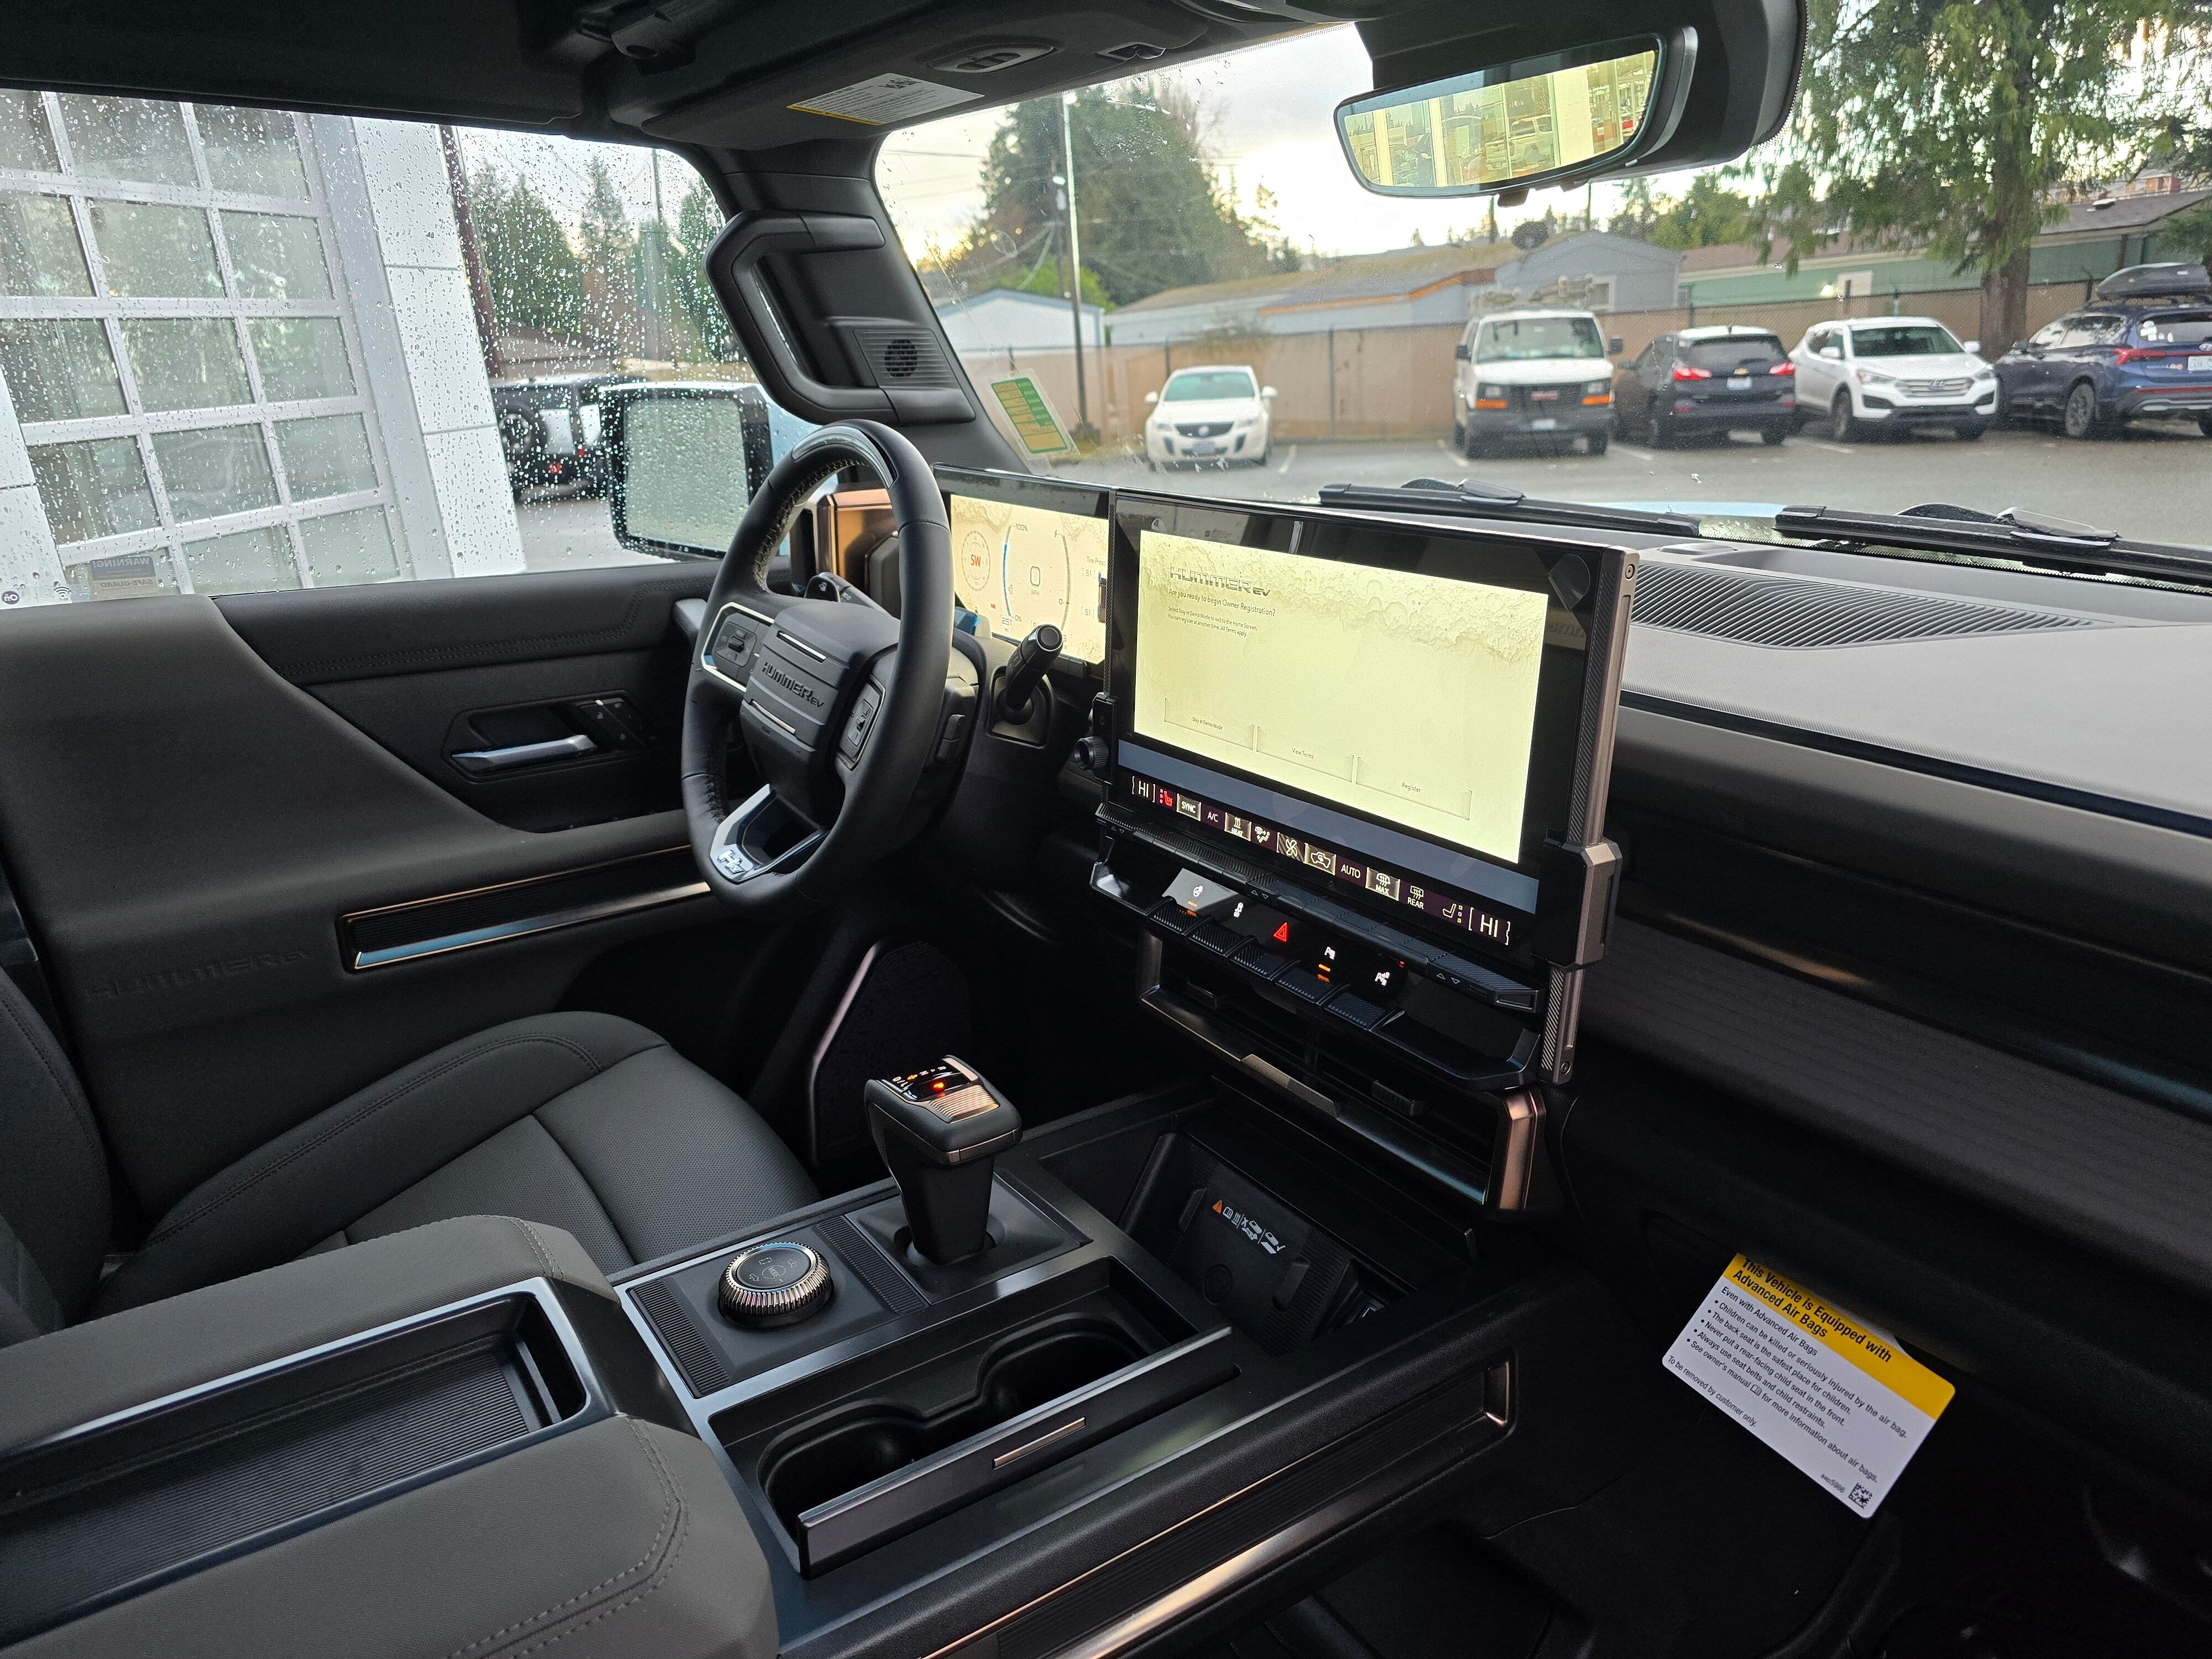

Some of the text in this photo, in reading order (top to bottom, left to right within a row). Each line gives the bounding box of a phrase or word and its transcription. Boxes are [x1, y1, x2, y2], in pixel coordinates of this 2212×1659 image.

[1015, 523, 1028, 531] 100%
[971, 554, 982, 567] SW
[1030, 565, 1041, 587] 0
[1170, 566, 1271, 597] HUMMER EV
[1168, 588, 1177, 596] Are
[1187, 592, 1200, 602] ready
[1207, 596, 1222, 606] begin
[1222, 599, 1239, 609] Owner
[1240, 602, 1276, 617] Registration?
[1001, 617, 1012, 626] 251
[1226, 626, 1237, 634] Terms
[1244, 623, 1258, 631] Screen.
[762, 661, 825, 708] HUMMER EV
[1302, 750, 1314, 759] Terms
[1138, 780, 1149, 798] HI
[1401, 782, 1421, 793] Register
[1181, 801, 1196, 813] SYNC
[1207, 811, 1218, 822] A/C
[1231, 827, 1244, 838] HEAT
[1340, 864, 1361, 878] AUTO
[1375, 884, 1390, 896] MAX
[1407, 896, 1425, 910] REAR
[1480, 914, 1499, 938] HI
[768, 1266, 780, 1277] MODE
[1732, 1269, 1827, 1337] Advanced Air Bags
[1743, 1257, 1891, 1362] This Vehicle is Equipped with
[1721, 1286, 1817, 1355] Even with Advanced Air Bags
[1712, 1311, 1850, 1414] The back seat is the safest place for children.
[1719, 1302, 1745, 1324] Children
[1745, 1322, 1758, 1333] can
[1758, 1329, 1768, 1339] be
[1767, 1336, 1788, 1353] killed
[1796, 1357, 1828, 1381] seriously
[1828, 1378, 1855, 1400] injured
[1854, 1396, 1865, 1407] by
[1865, 1404, 1877, 1416] the
[1879, 1415, 1890, 1424] air
[1890, 1421, 1906, 1437] bag.
[1697, 1331, 1824, 1428] Always use seat belts and child restraints.
[1704, 1321, 1724, 1337] Never
[1721, 1335, 1735, 1346] put
[1739, 1347, 1774, 1375] rear-facing
[1774, 1372, 1792, 1386] child
[1790, 1384, 1806, 1397] seat
[1806, 1394, 1813, 1403] in
[1814, 1400, 1826, 1411] the
[1826, 1408, 1844, 1426] front.
[1668, 1355, 1756, 1427] To be removed by customer only.
[1691, 1340, 1876, 1482] See owner's manual for more information about air bags.
